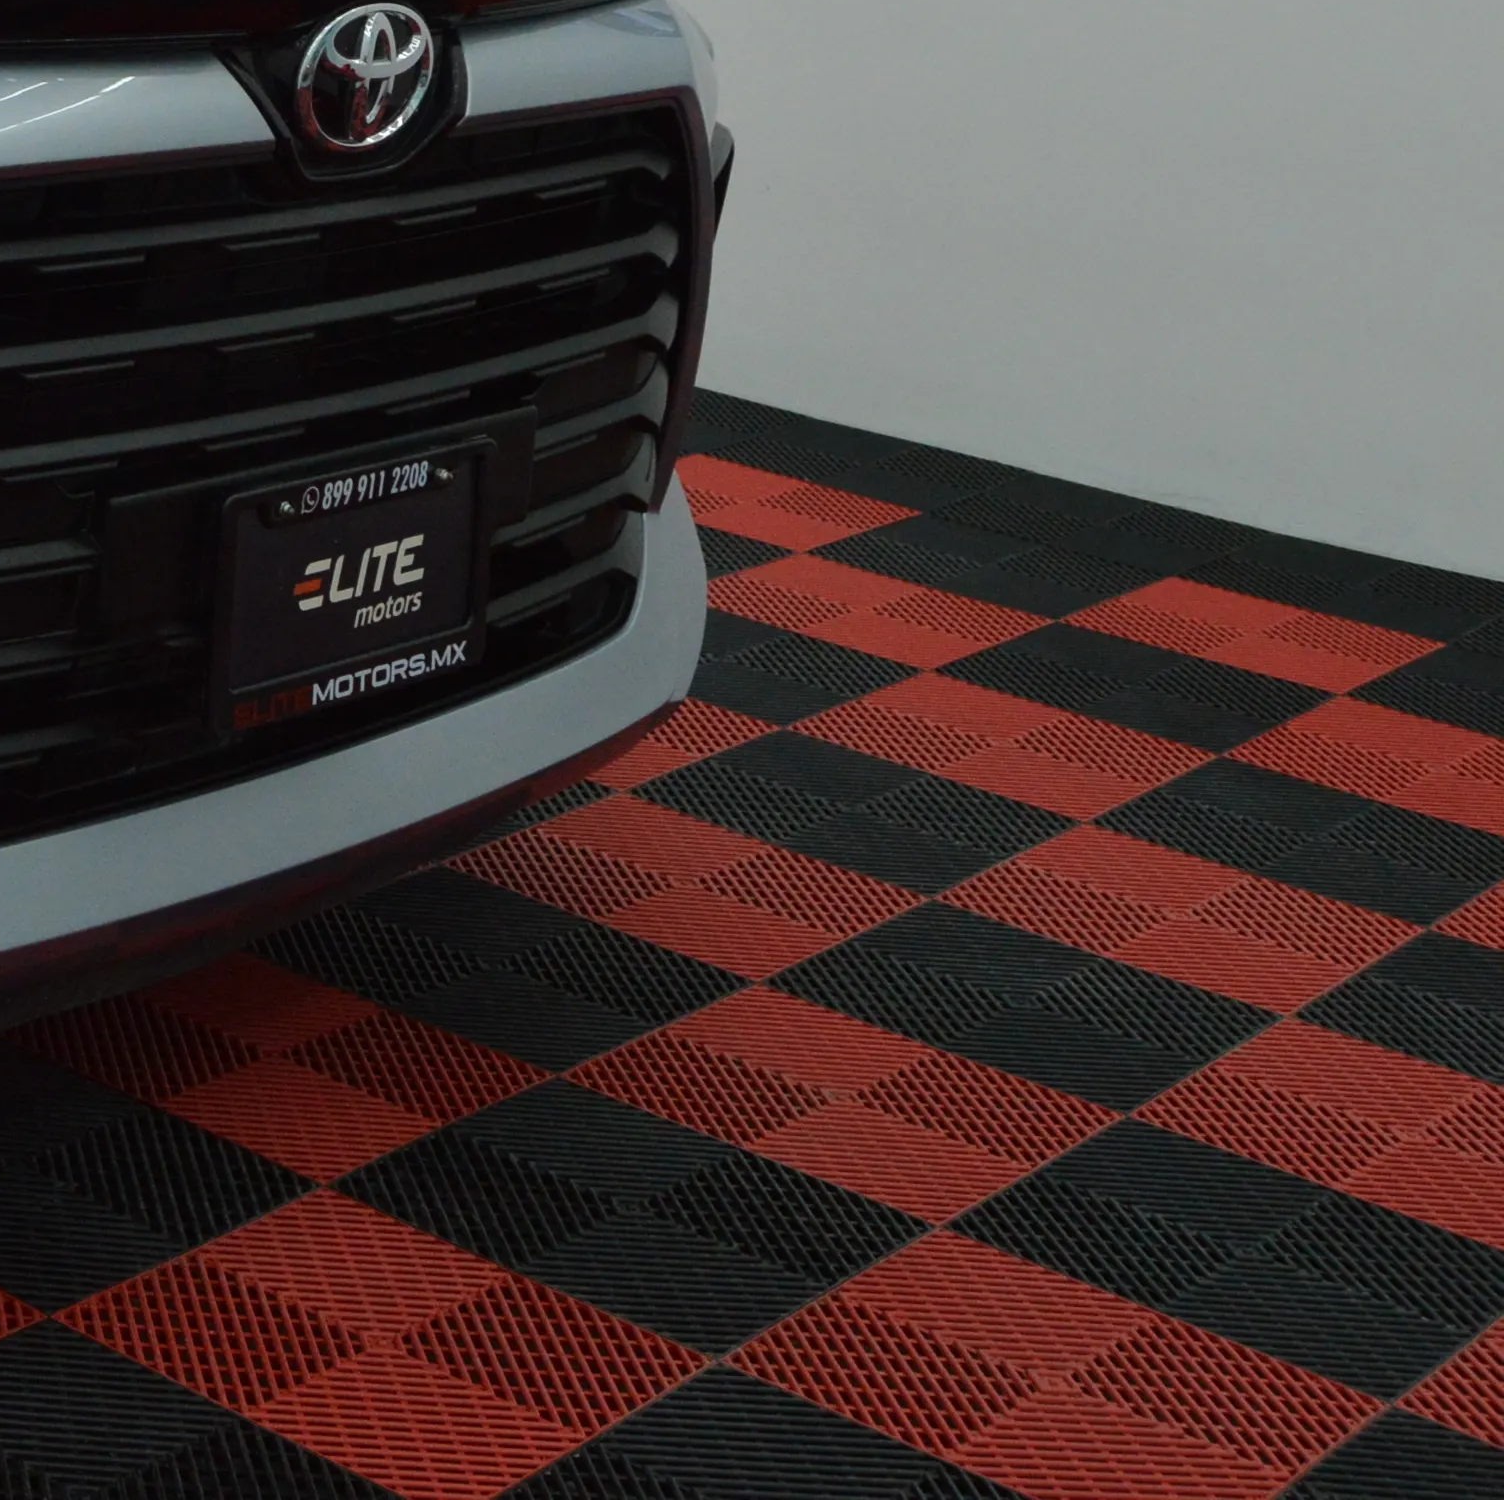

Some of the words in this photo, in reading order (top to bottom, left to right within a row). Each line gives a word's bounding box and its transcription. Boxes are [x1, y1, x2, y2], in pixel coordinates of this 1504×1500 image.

[322, 477, 353, 511] 899
[358, 470, 386, 501] 911
[390, 460, 429, 494] 2208
[293, 533, 425, 612] ELITE
[353, 591, 422, 629] motors
